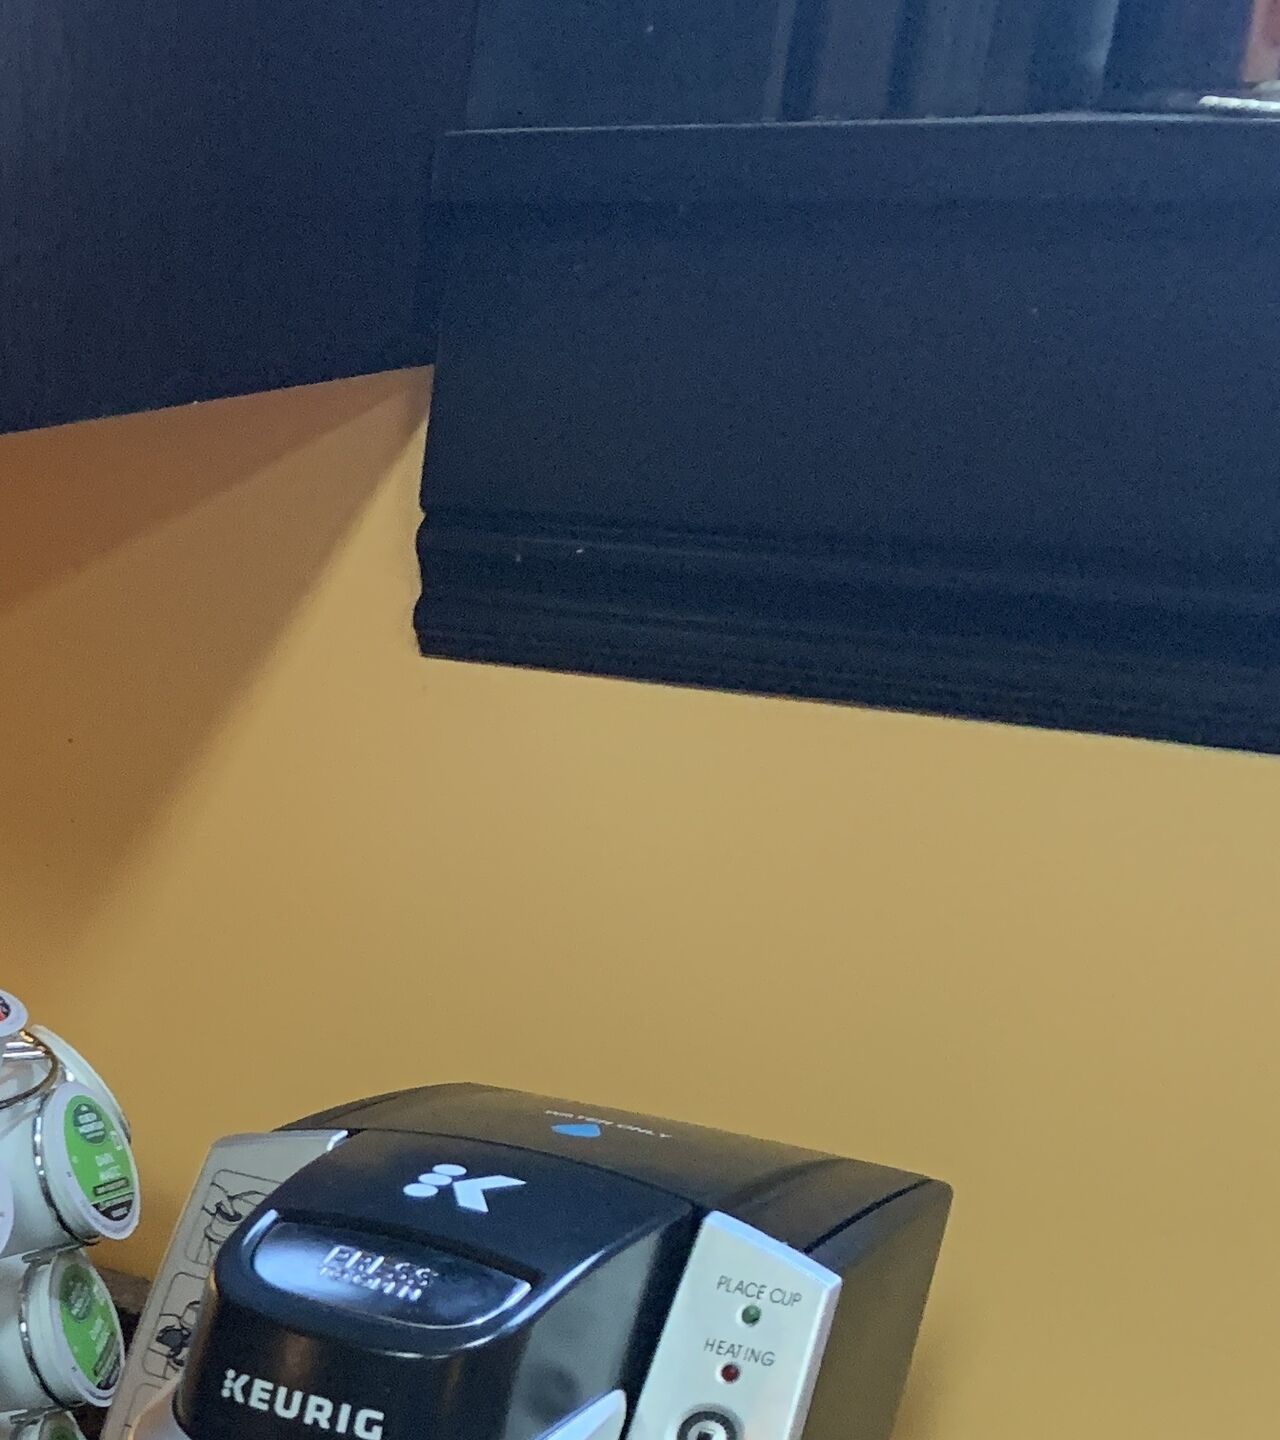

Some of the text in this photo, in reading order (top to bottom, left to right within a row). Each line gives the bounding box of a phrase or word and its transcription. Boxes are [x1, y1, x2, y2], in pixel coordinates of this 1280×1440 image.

[716, 1275, 803, 1307] PLACE CUP
[704, 1338, 776, 1367] HEATING
[221, 1368, 385, 1440] KEURIG
